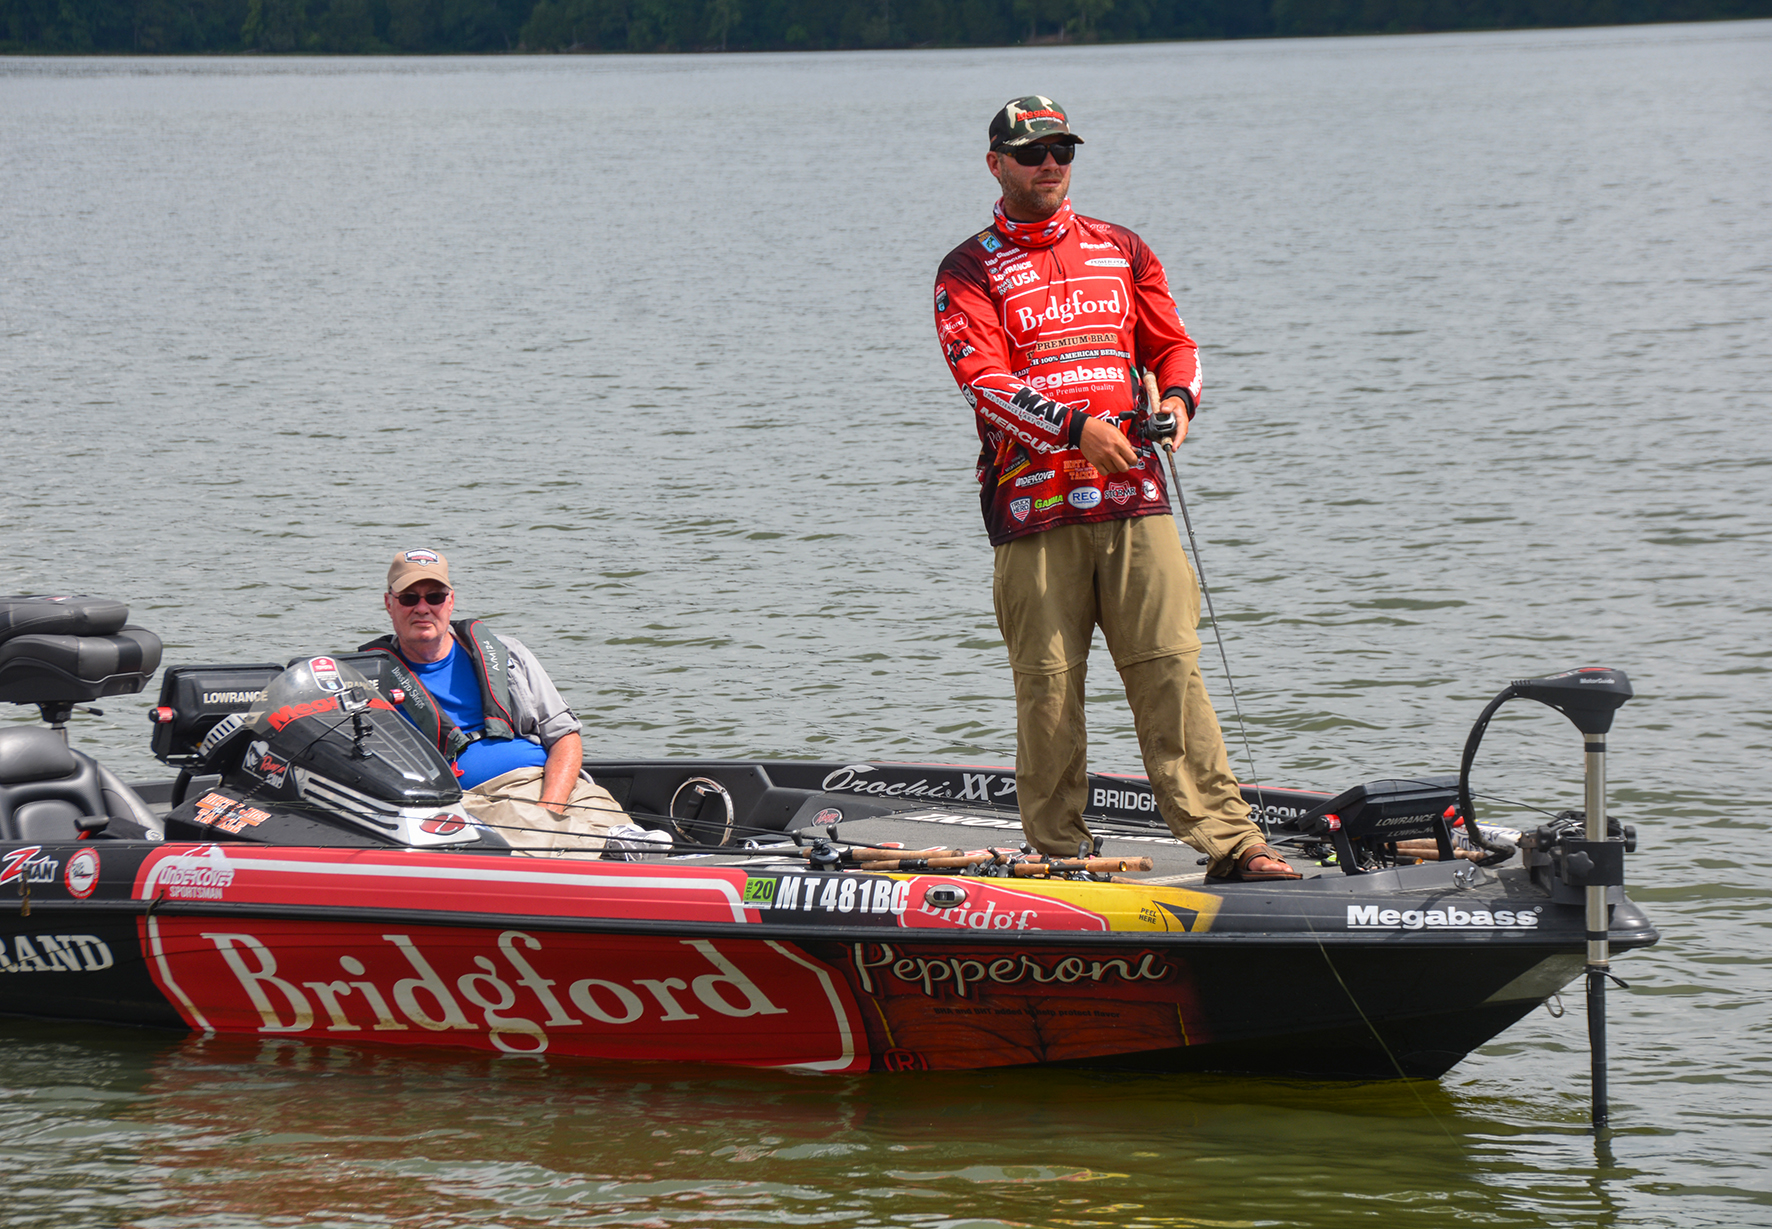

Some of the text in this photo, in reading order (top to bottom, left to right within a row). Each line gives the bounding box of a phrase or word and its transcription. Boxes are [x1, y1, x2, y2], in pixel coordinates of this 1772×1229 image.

[1011, 270, 1041, 286] USA
[1015, 289, 1121, 332] Brdgford
[1037, 335, 1089, 351] PREMIUM
[1041, 356, 1059, 365] 100%
[1060, 349, 1100, 361] AMERICAN
[1056, 386, 1089, 397] Premium
[1091, 384, 1115, 393] Quality
[1069, 471, 1099, 480] TACKLE
[1073, 491, 1098, 501] REC
[203, 690, 269, 704] LOWRANCE
[955, 773, 996, 800] XX
[1375, 813, 1436, 827] LOWRANCE
[158, 867, 235, 888] UNDERCOVER
[169, 886, 224, 900] SPORTSMAN
[752, 880, 774, 899] 20
[1138, 914, 1157, 925] HERE
[1140, 907, 1157, 918] PEEL
[1347, 905, 1539, 930] Megabass
[854, 942, 1168, 998] Pepperoni
[200, 929, 789, 1054] Bridgford
[934, 1006, 954, 1015] BHA
[955, 1007, 973, 1015] and
[974, 1007, 992, 1015] BHT
[994, 1007, 1023, 1016] added
[1035, 1008, 1055, 1018] help
[1058, 1009, 1092, 1018] protect
[1093, 1010, 1121, 1018] flavor
